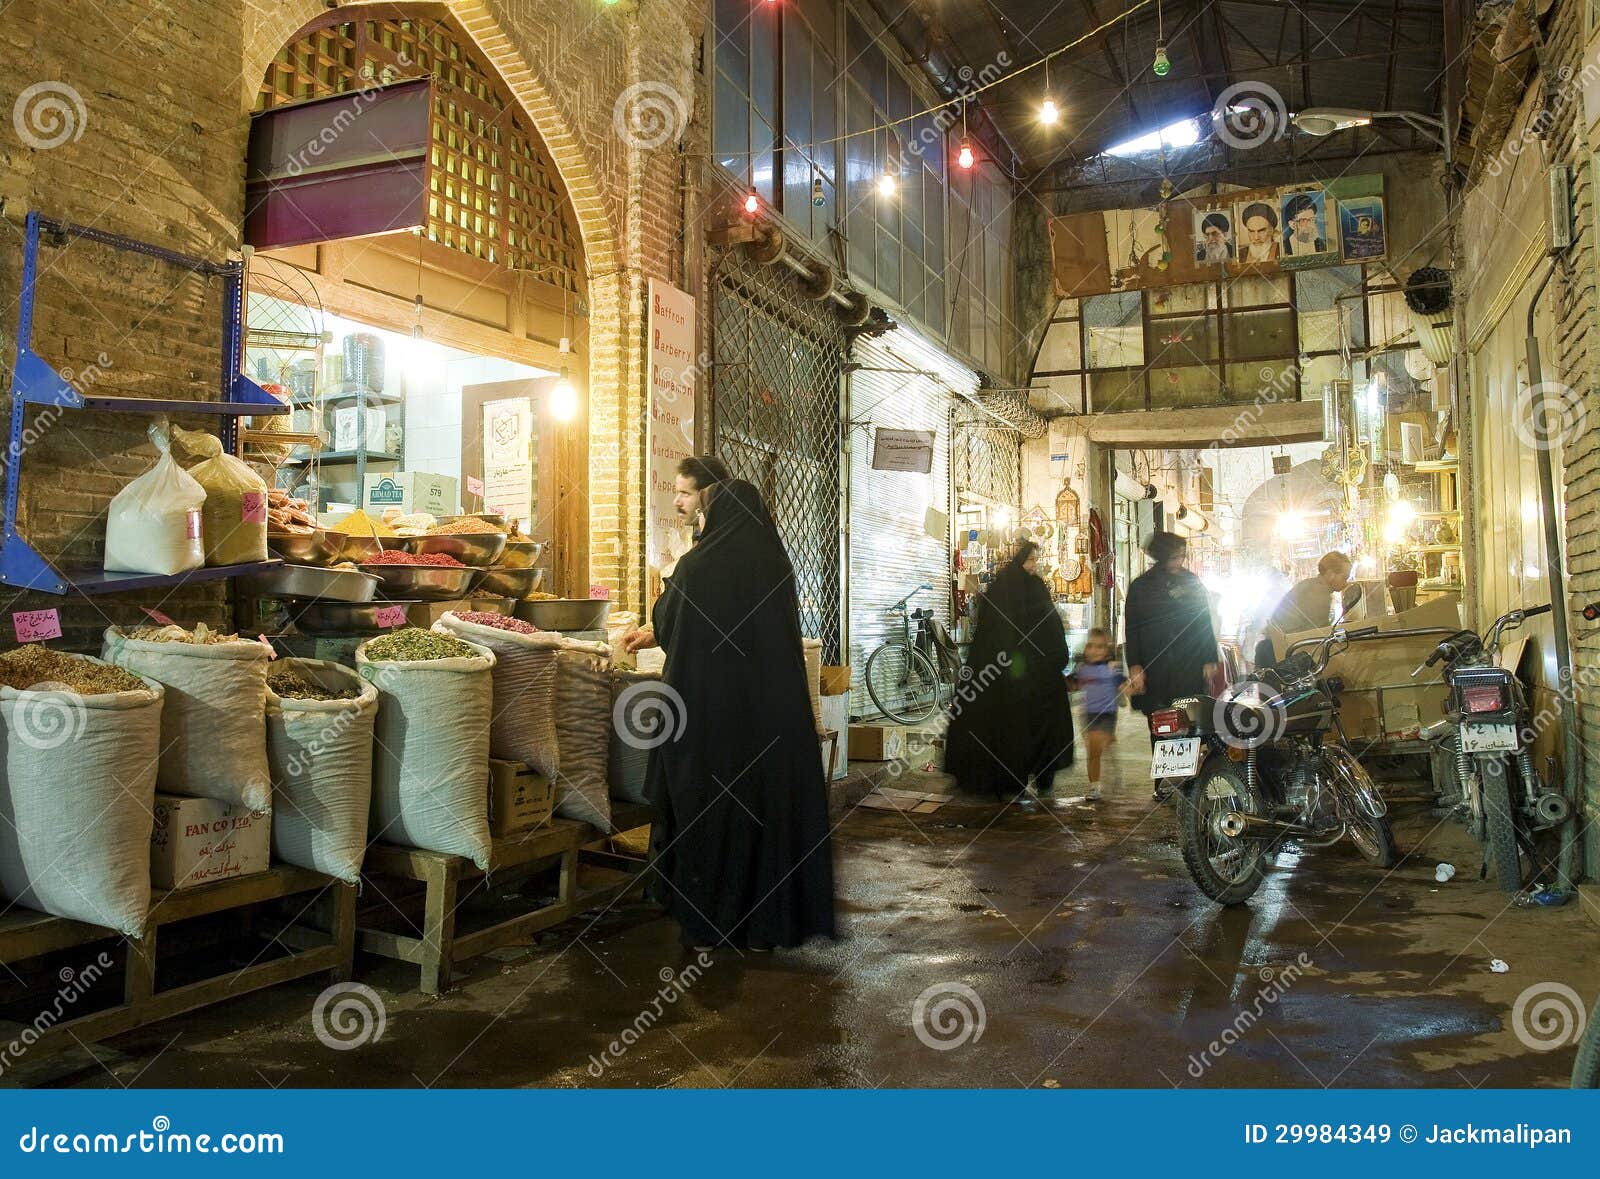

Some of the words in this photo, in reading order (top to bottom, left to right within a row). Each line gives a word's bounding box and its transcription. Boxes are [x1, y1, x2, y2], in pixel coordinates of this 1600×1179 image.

[654, 294, 685, 325] Saffron
[654, 329, 691, 361] Barberry
[653, 365, 692, 396] Cinnamon
[652, 400, 679, 425] Ginger
[430, 488, 442, 497] 579
[652, 470, 677, 495] Peppe
[184, 822, 210, 837] FAN
[212, 820, 229, 833] CO
